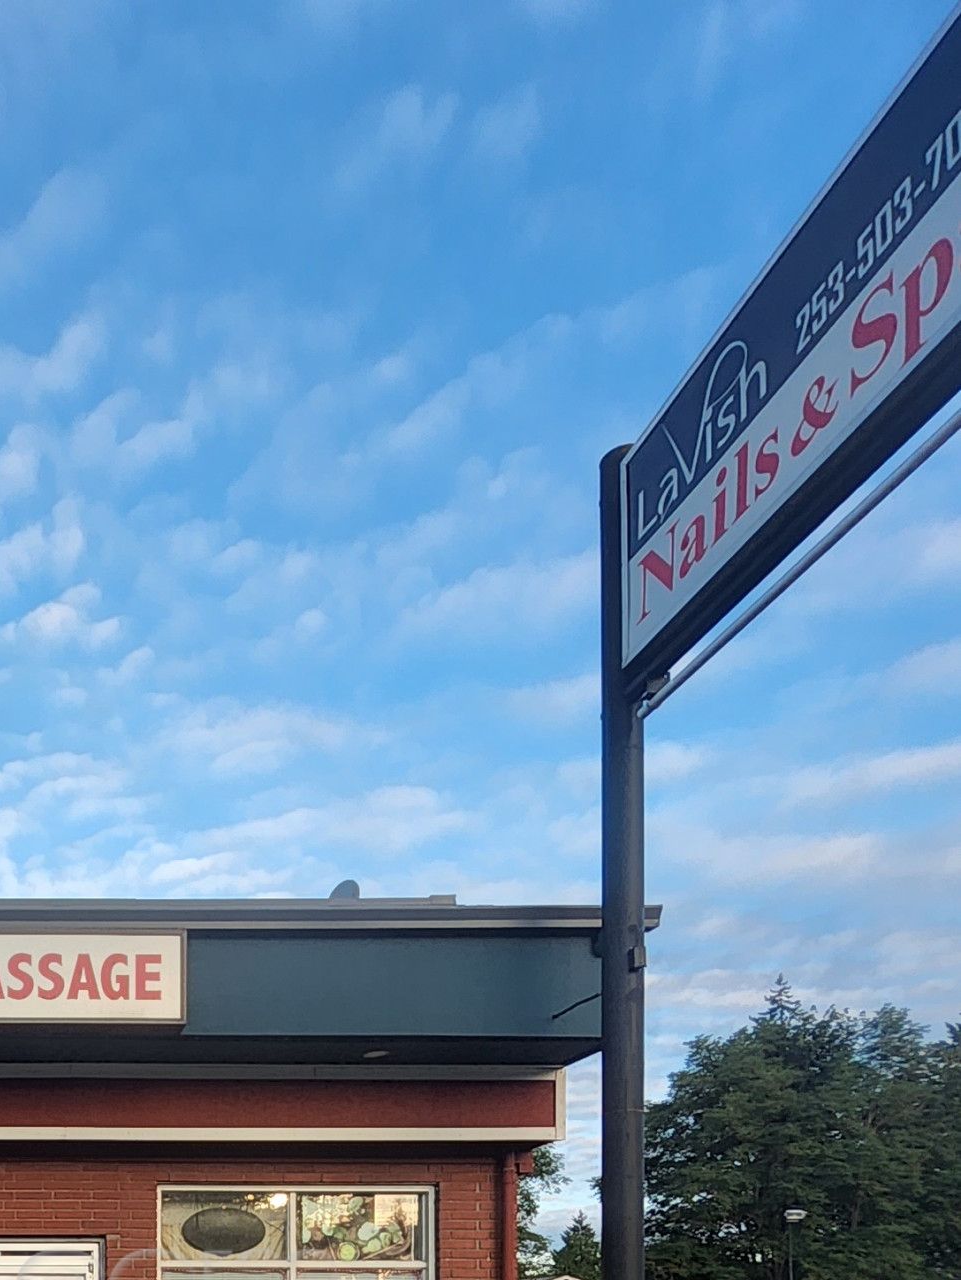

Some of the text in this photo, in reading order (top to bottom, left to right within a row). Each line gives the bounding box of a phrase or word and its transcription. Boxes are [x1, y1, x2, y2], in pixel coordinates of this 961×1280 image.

[636, 222, 961, 626] Nails & Sp
